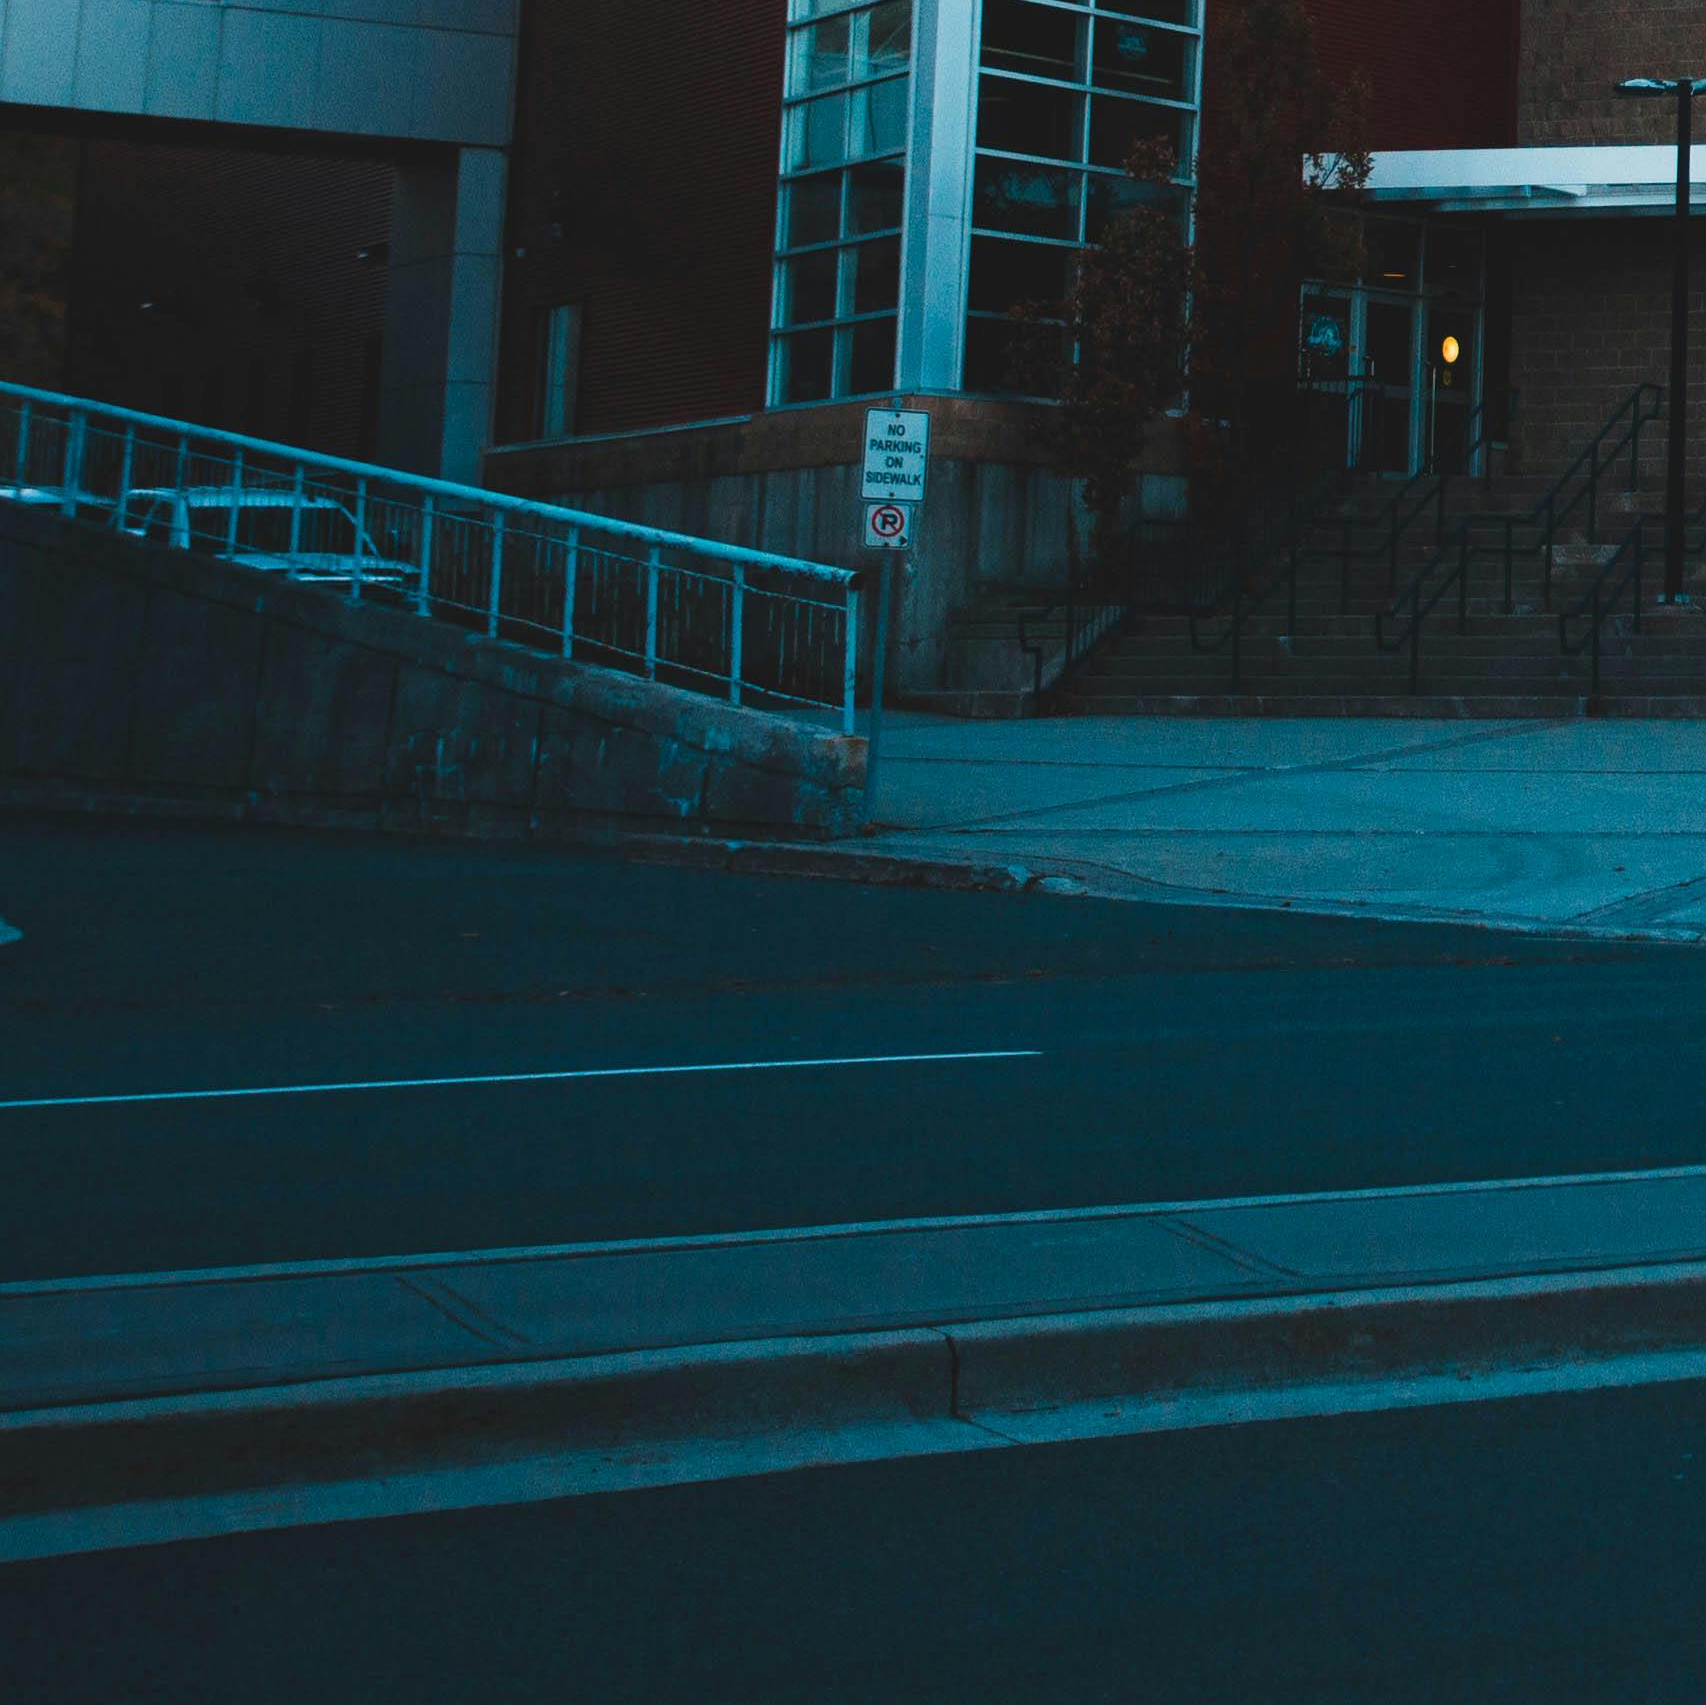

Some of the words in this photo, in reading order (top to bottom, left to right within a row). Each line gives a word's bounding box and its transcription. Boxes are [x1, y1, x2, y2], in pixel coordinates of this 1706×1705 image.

[888, 424, 905, 436] NO
[869, 439, 921, 454] PARKING
[885, 456, 903, 468] ON
[865, 471, 921, 486] SIDEWALK
